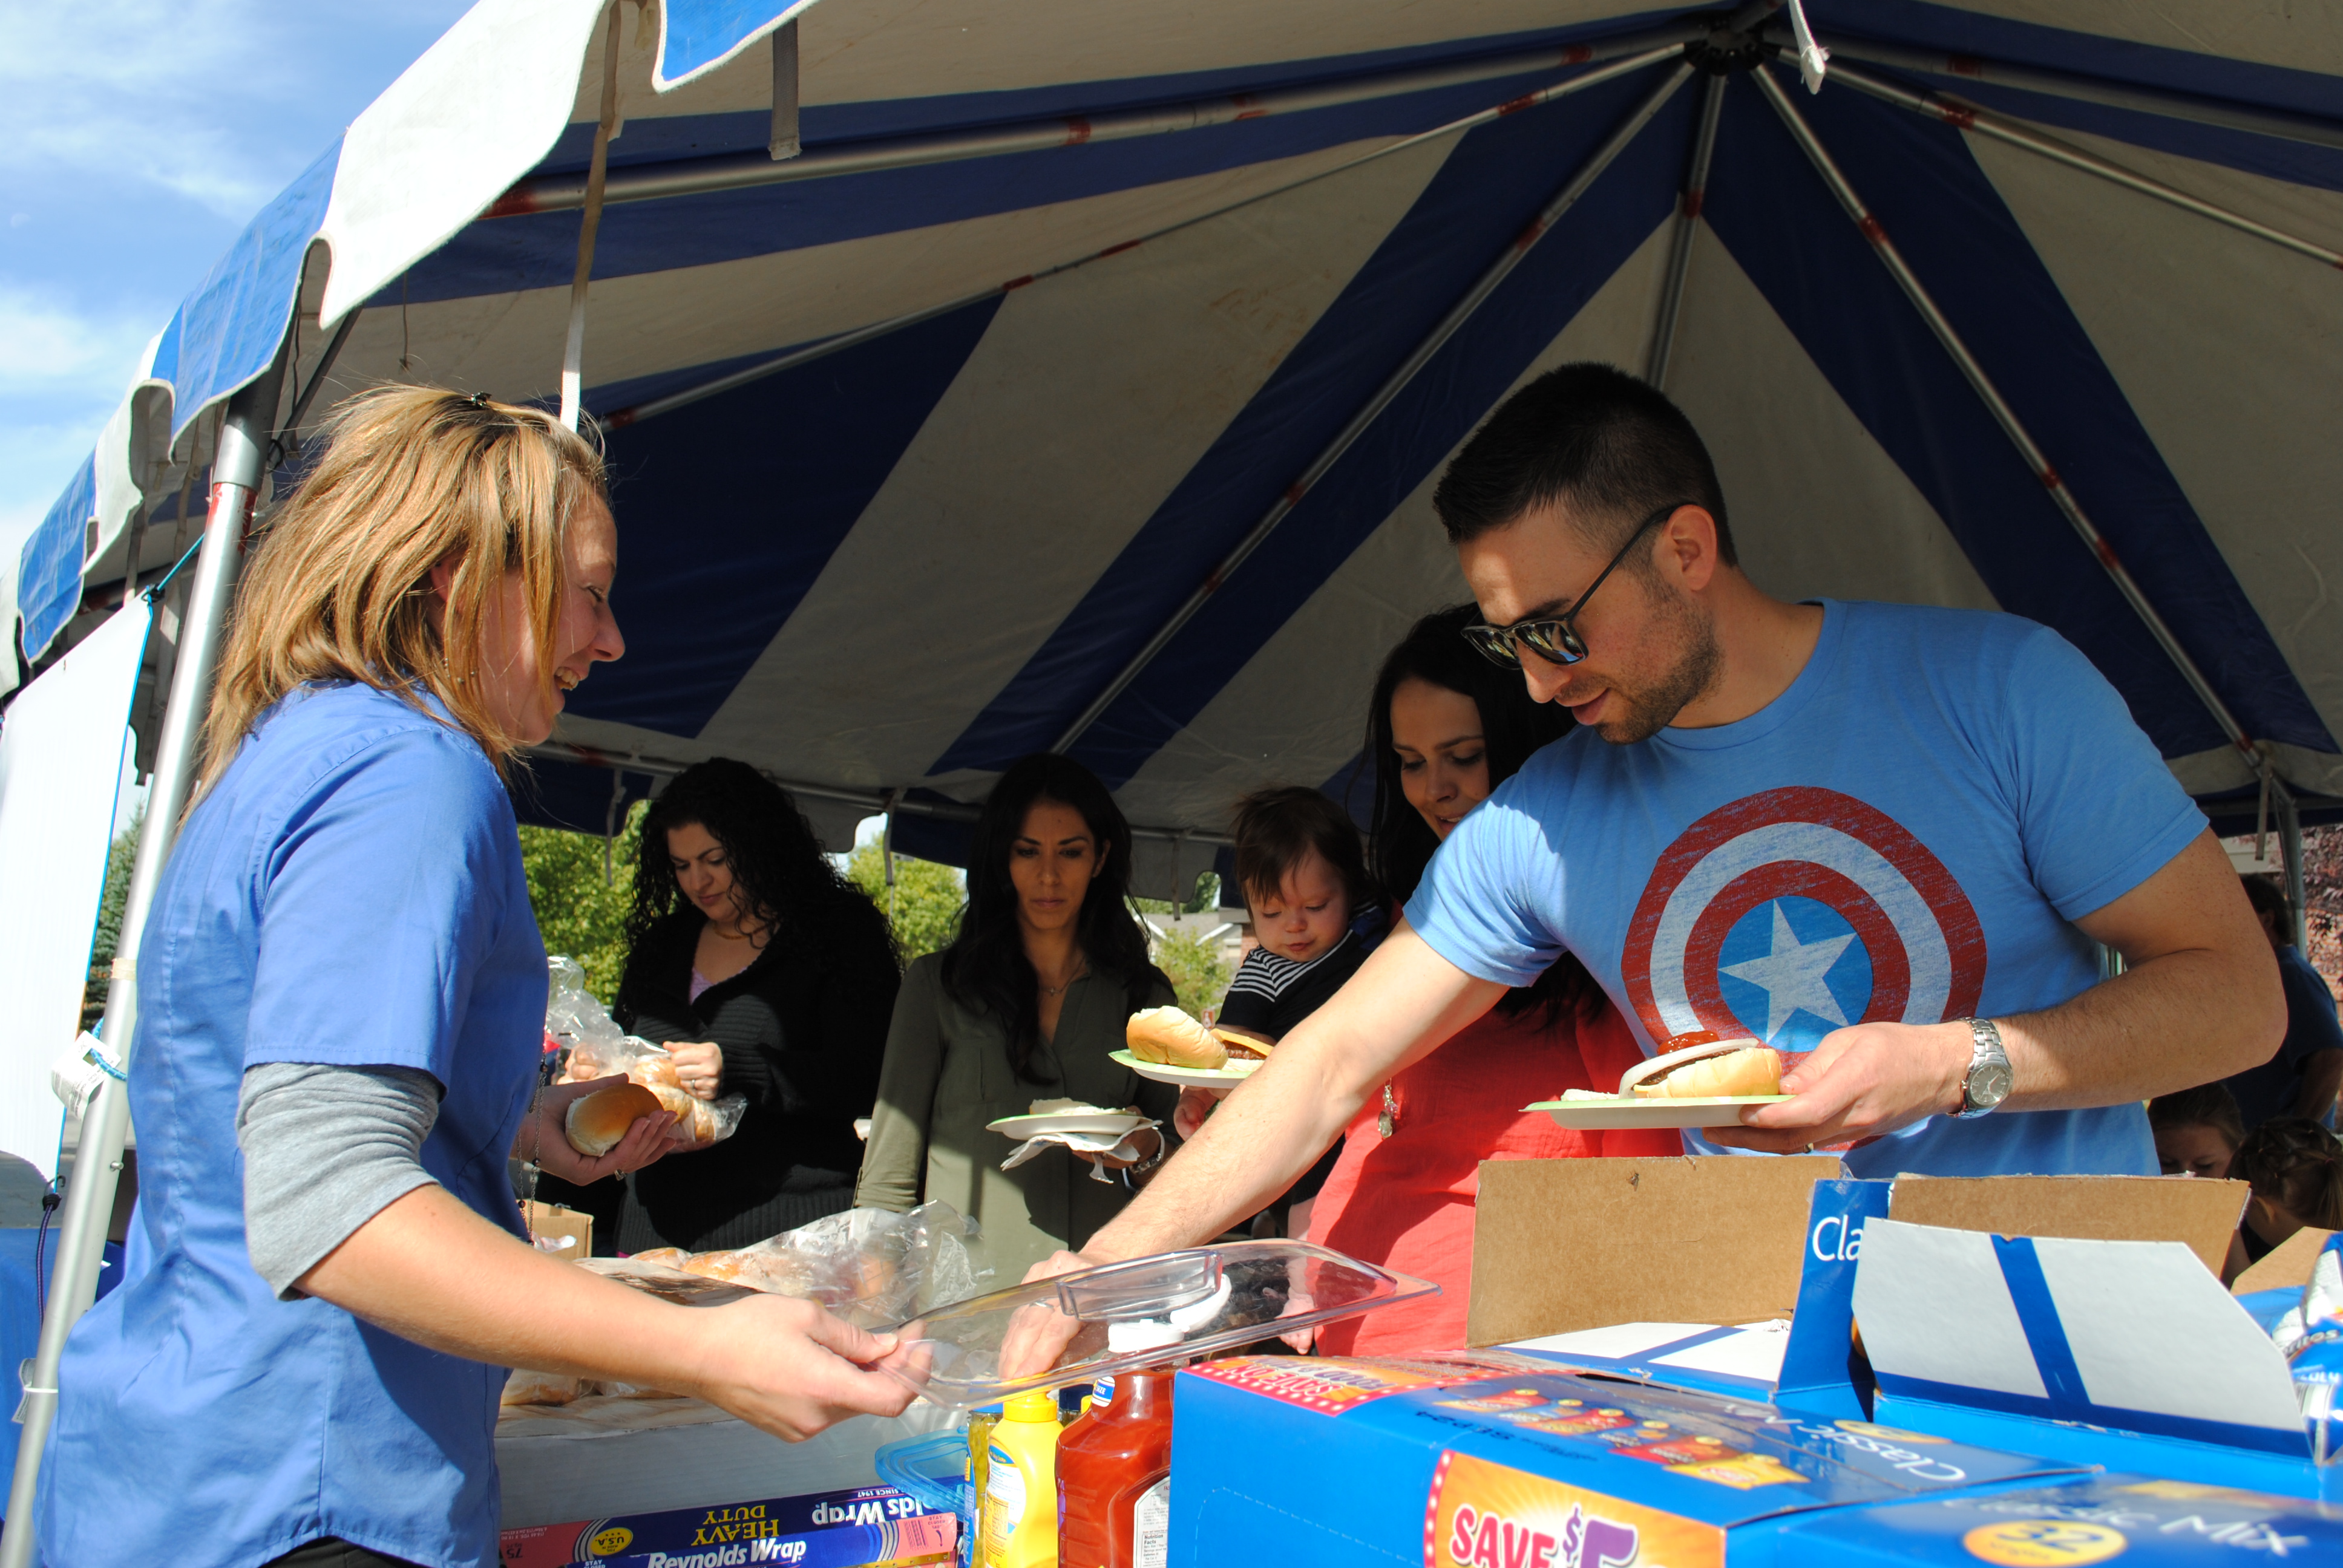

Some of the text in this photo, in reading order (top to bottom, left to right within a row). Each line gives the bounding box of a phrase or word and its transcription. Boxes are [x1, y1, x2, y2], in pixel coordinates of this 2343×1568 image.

[1258, 1372, 1345, 1397] SAVE
[1313, 1370, 1398, 1391] FOOD
[1797, 1424, 1967, 1481] Classic
[857, 1490, 874, 1498] 1947
[703, 1505, 766, 1525] DUTY
[811, 1501, 886, 1527] Wrap
[691, 1519, 779, 1546] HEAVY
[1450, 1505, 1556, 1568] SAVE
[506, 1548, 523, 1559] 75
[647, 1537, 807, 1568] Reynolds Wrap
